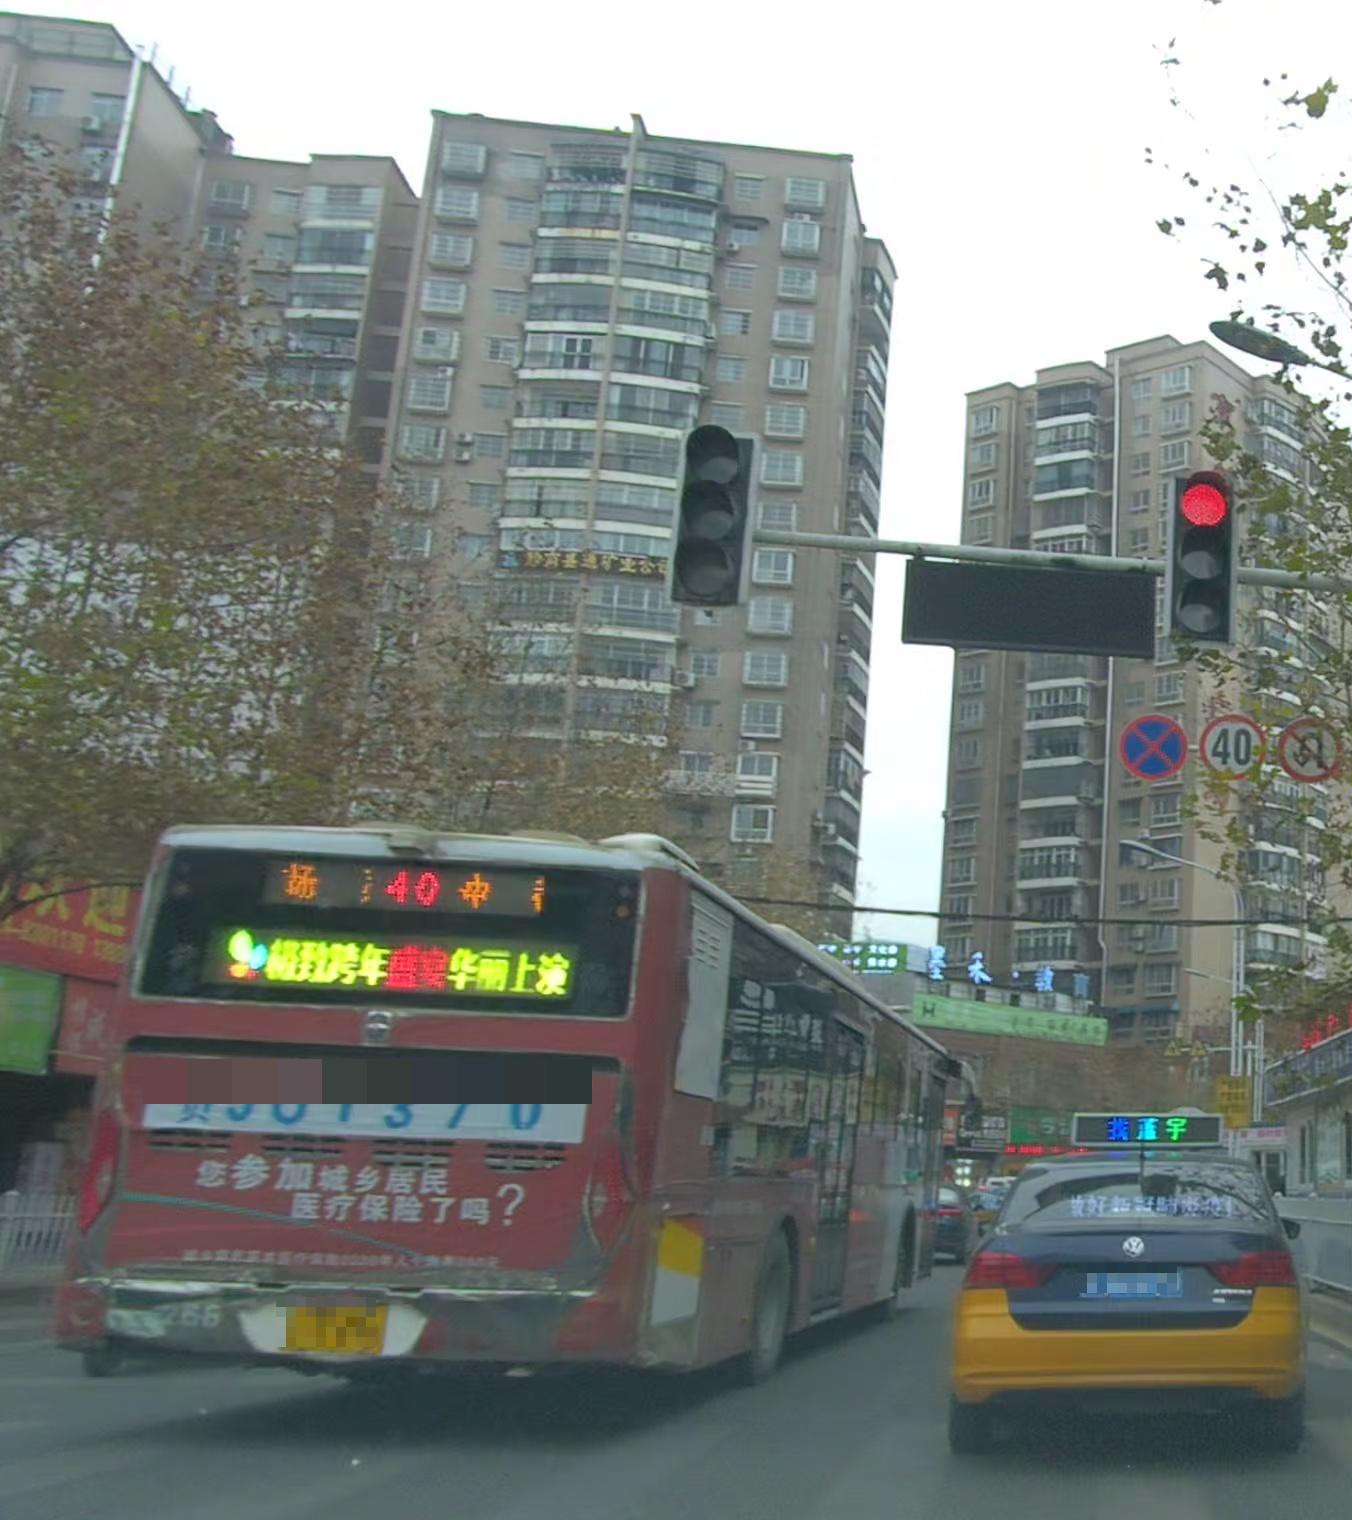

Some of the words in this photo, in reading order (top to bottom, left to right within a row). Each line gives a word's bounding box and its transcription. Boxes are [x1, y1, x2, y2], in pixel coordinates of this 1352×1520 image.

[1211, 718, 1252, 766] 40
[384, 870, 440, 907] 40
[195, 1153, 449, 1195] 您参加城乡居民
